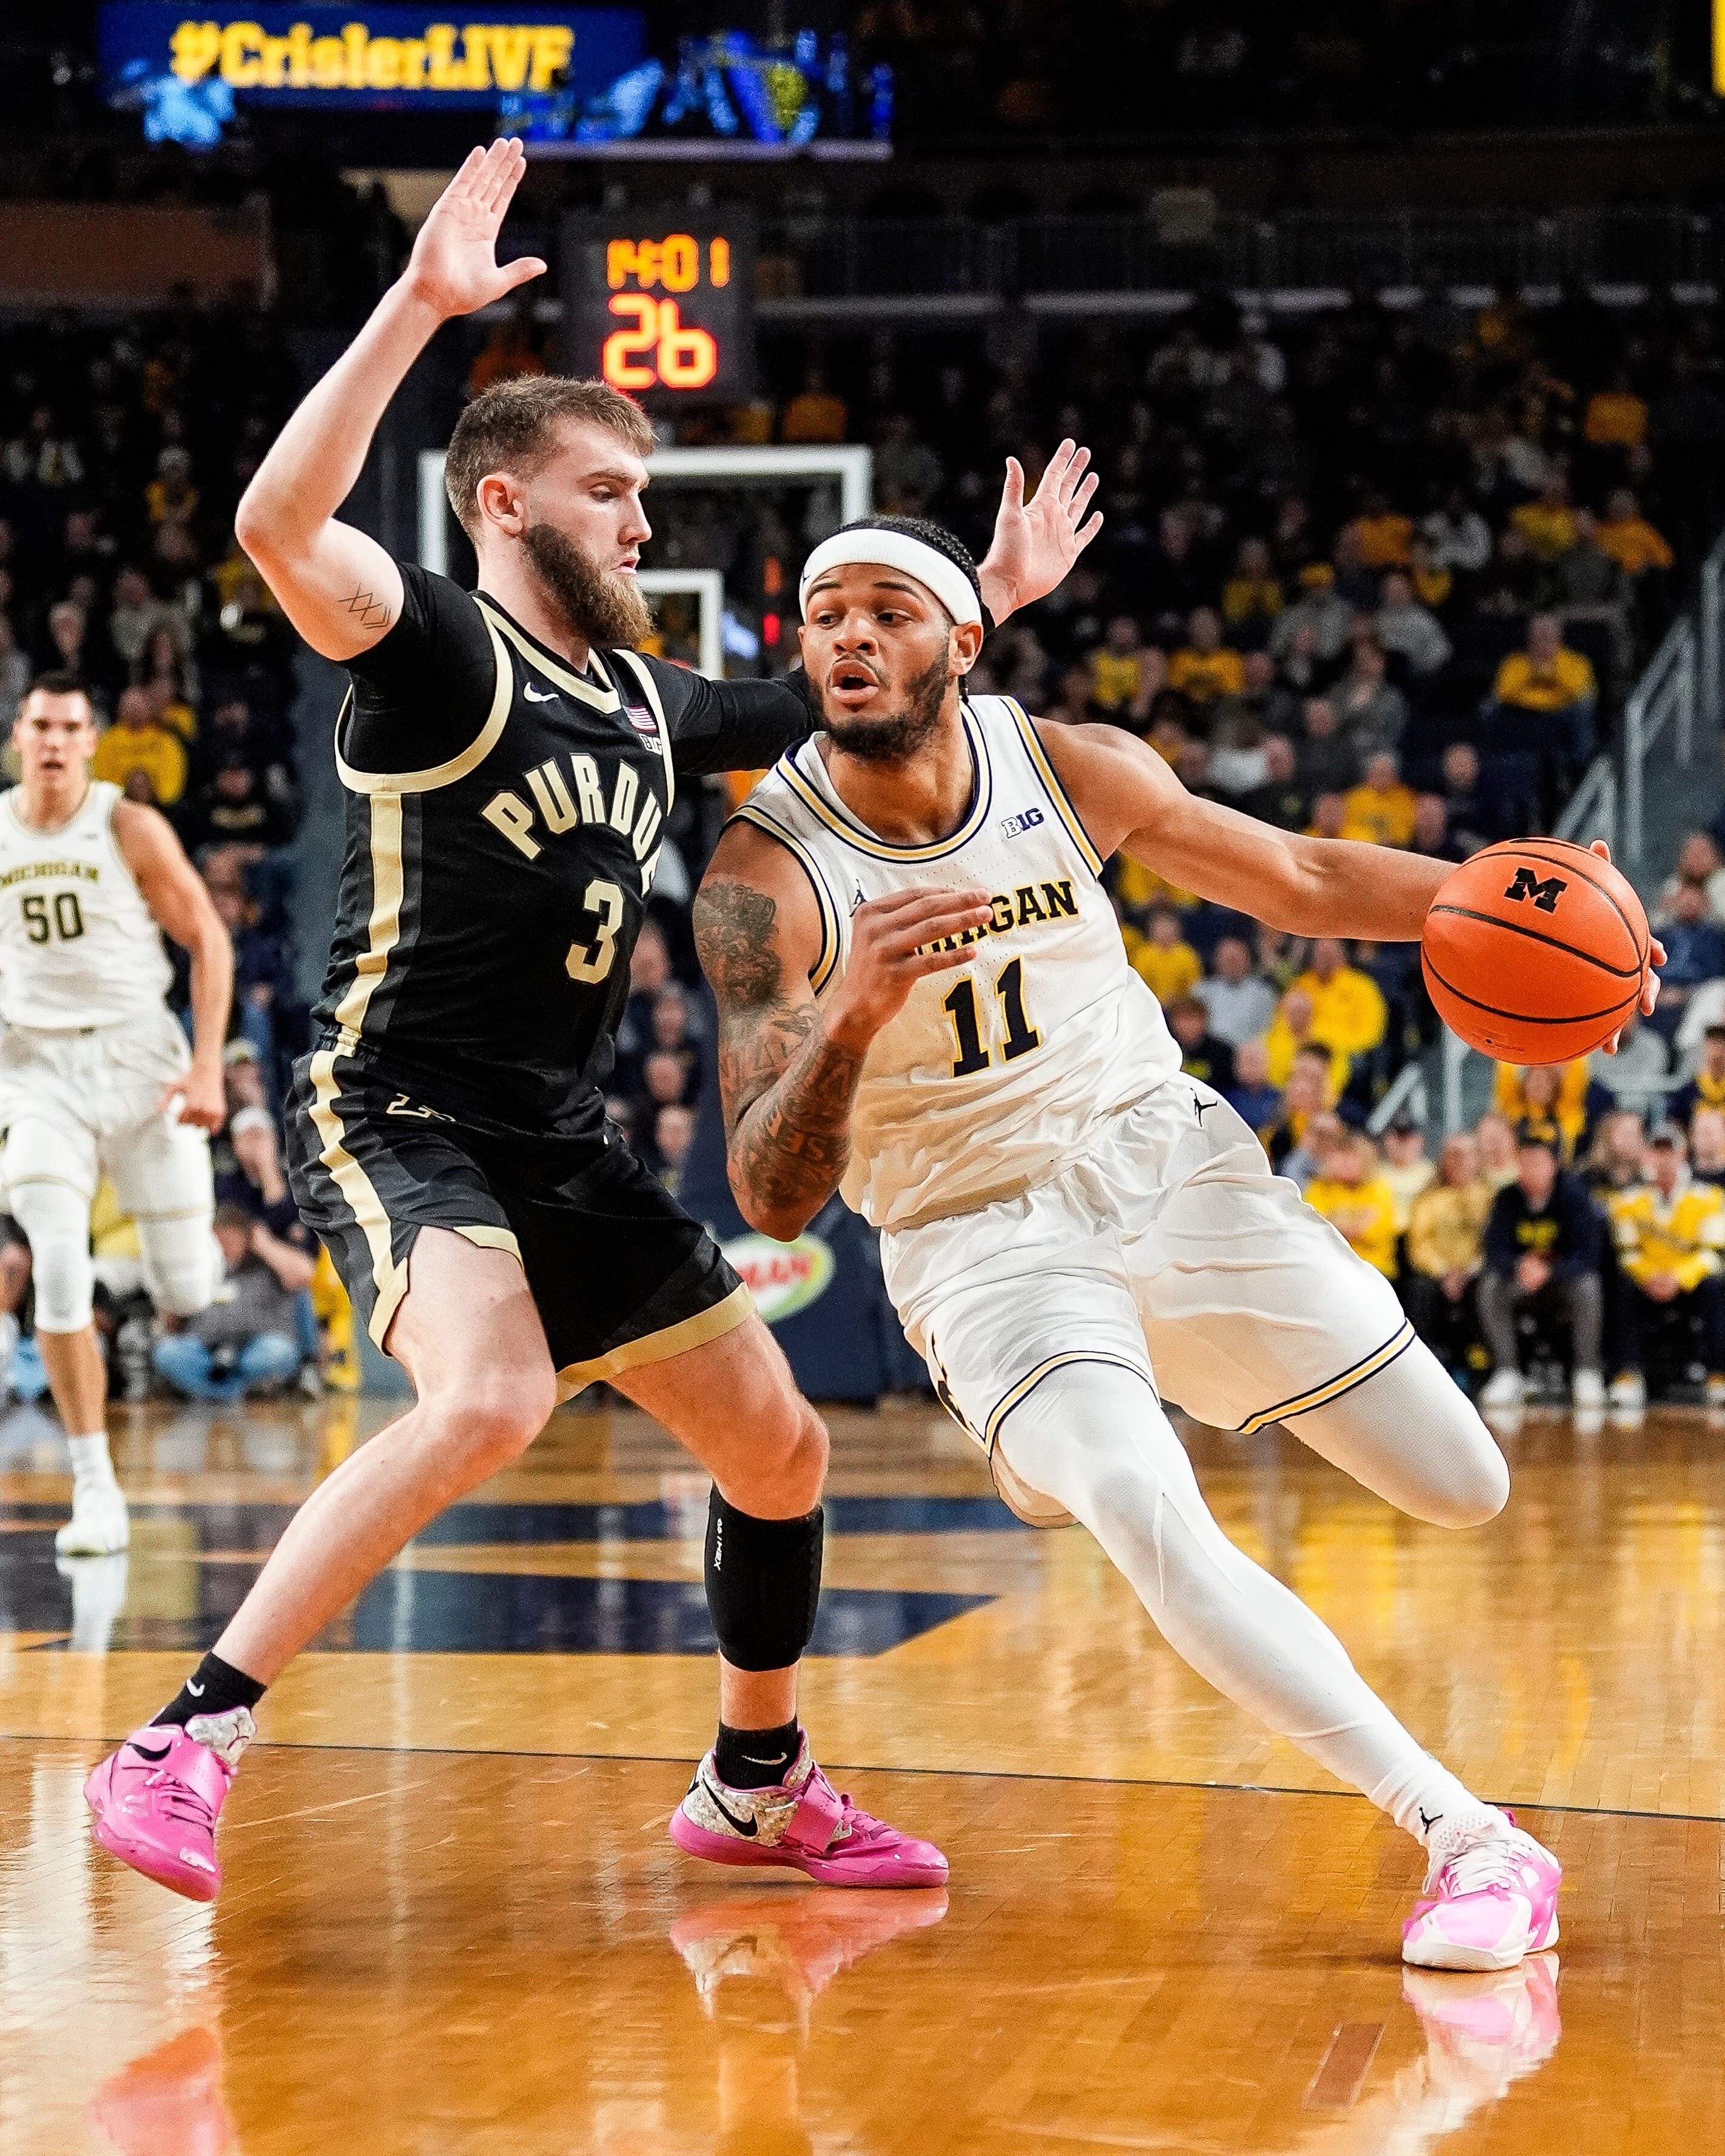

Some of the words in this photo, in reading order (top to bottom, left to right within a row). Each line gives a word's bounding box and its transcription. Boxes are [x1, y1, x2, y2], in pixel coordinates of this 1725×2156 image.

[607, 235, 729, 292] 14:01
[603, 293, 716, 389] 26
[22, 890, 84, 945] 50
[1504, 867, 1567, 914] M
[565, 877, 624, 984] 3
[942, 955, 1043, 1078] 11
